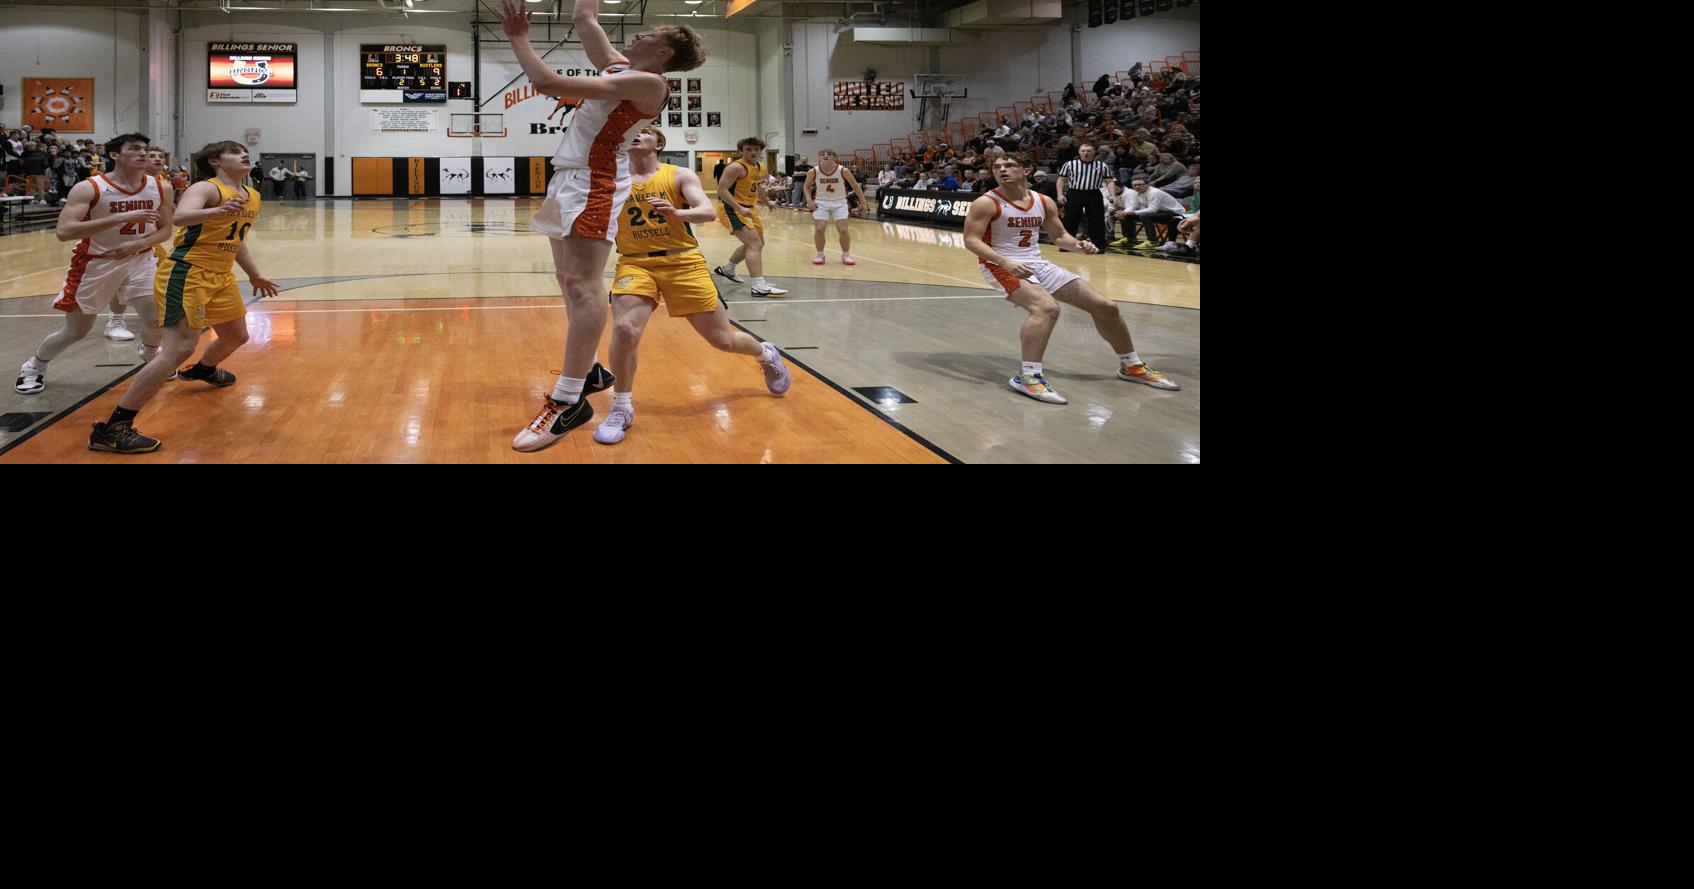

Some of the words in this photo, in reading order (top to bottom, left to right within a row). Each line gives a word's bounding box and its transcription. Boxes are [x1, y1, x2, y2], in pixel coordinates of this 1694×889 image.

[395, 54, 419, 62] 3:48
[375, 68, 383, 76] 6
[433, 68, 440, 76] 9
[566, 68, 582, 77] OF
[585, 69, 601, 77] TH
[833, 82, 904, 95] UNITED
[833, 95, 857, 107] WE
[859, 95, 904, 107] STAND
[825, 184, 835, 193] 4
[109, 199, 154, 213] SENIOR
[895, 196, 937, 213] BILLINGS
[627, 206, 666, 227] 24
[1007, 216, 1043, 228] SENIOR
[632, 227, 671, 239] RUSSELL
[1018, 230, 1033, 247] 2
